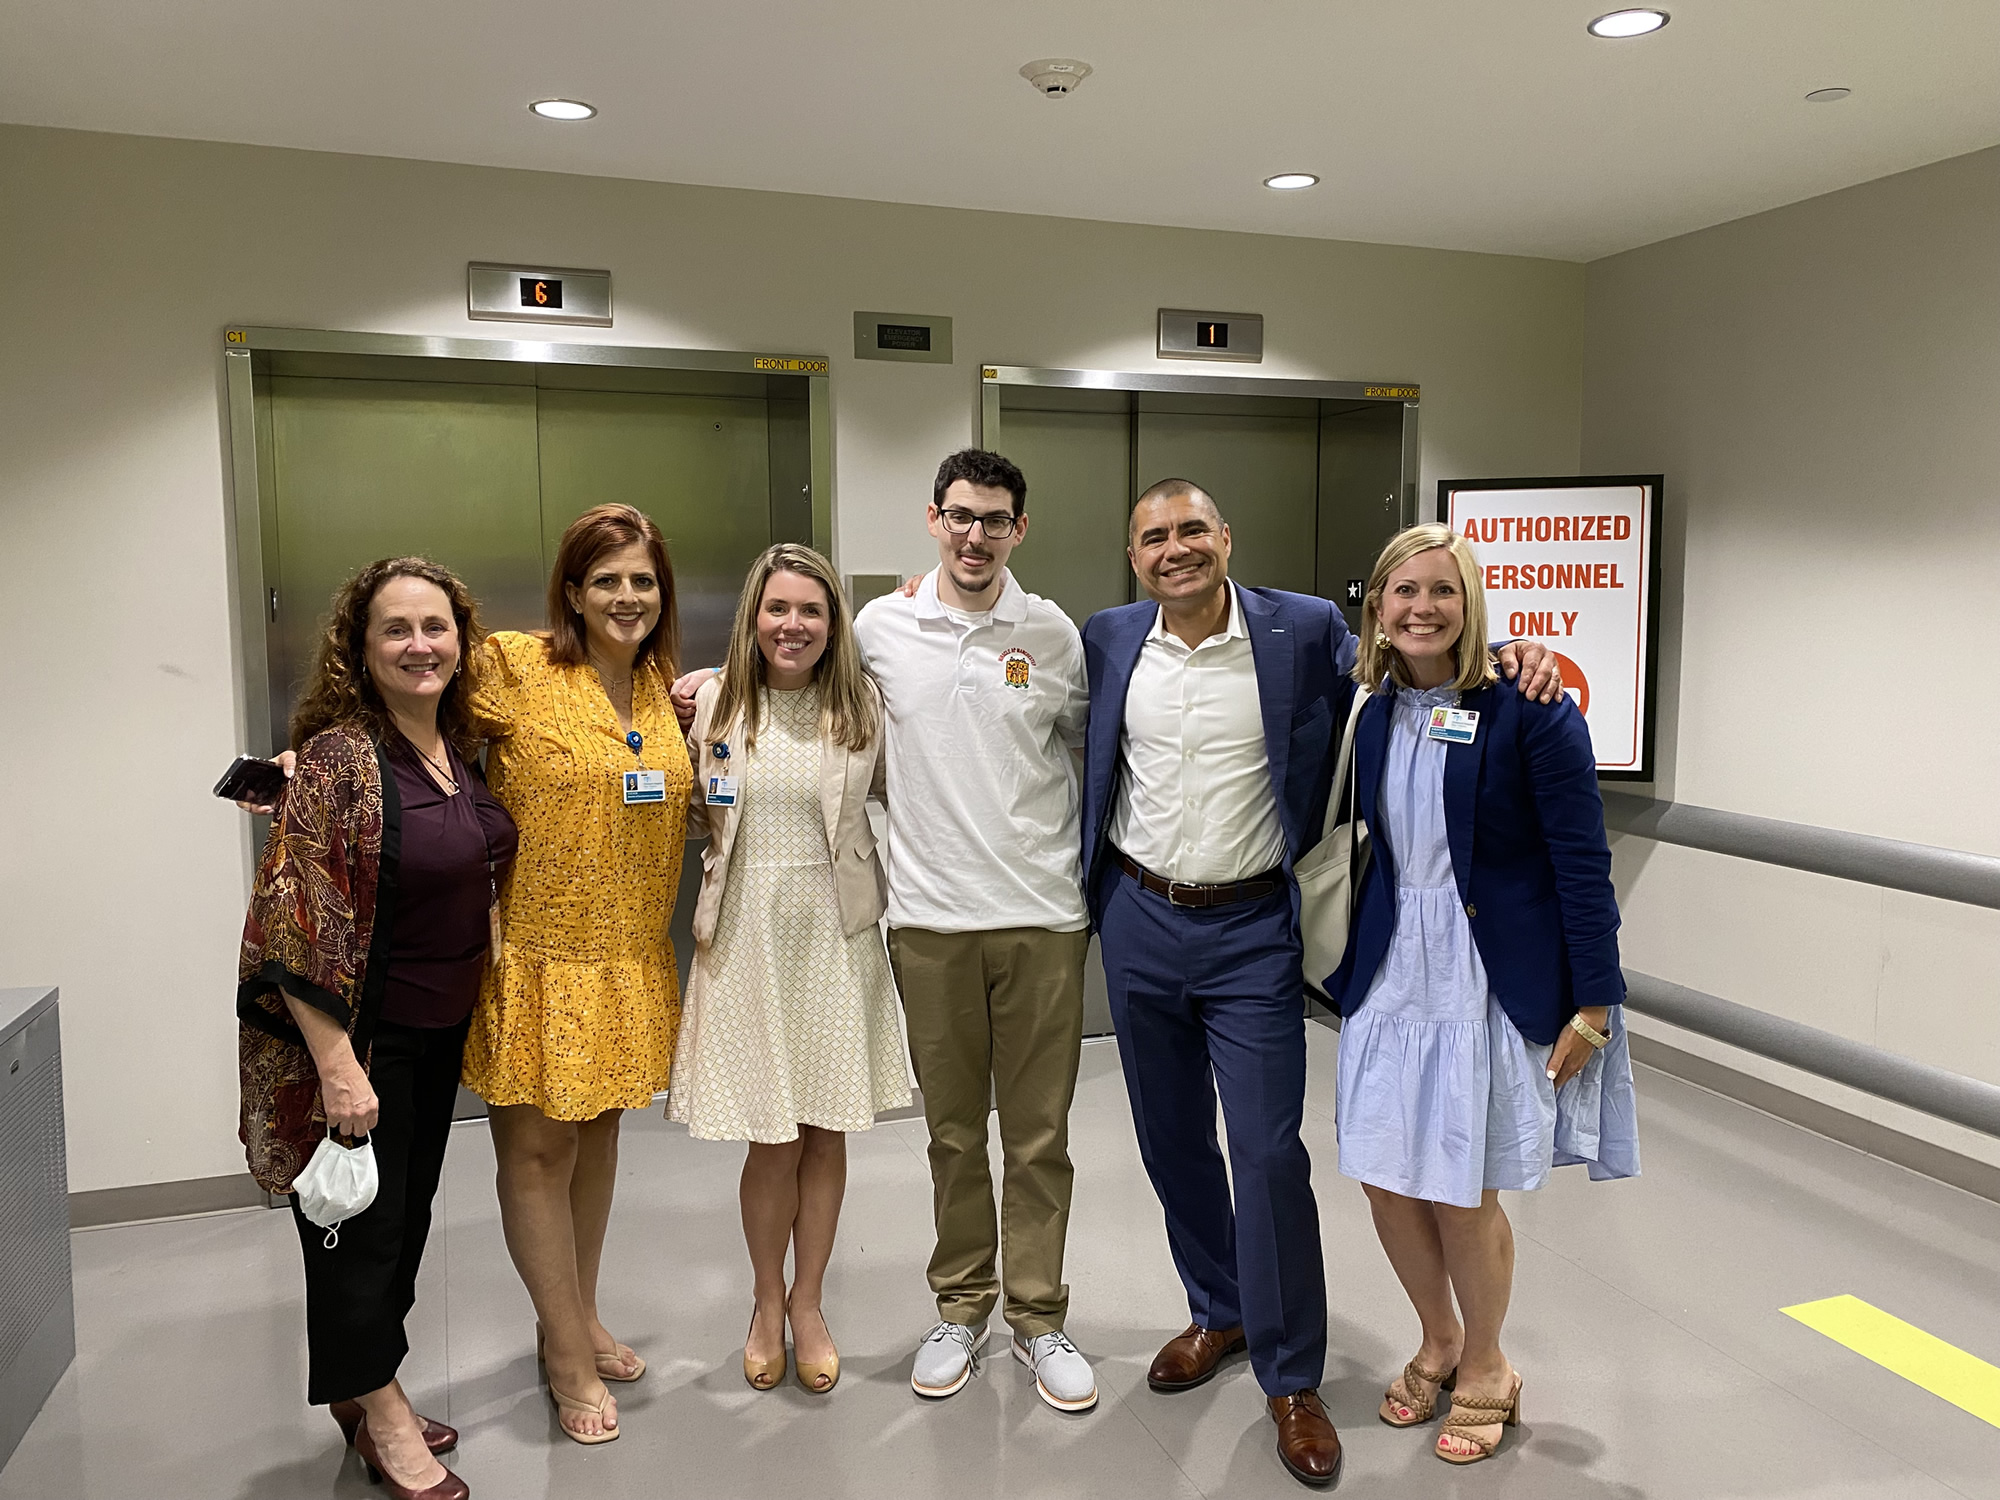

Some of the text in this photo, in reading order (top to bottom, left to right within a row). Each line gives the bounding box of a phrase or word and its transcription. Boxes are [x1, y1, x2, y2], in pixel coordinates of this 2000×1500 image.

[535, 281, 547, 304] 6
[227, 331, 243, 343] C1
[884, 334, 923, 343] EMERGENCY
[887, 328, 921, 336] ELEVATOR
[1209, 324, 1215, 344] 1
[755, 358, 827, 373] FRONT DOOR
[983, 368, 997, 379] C2
[1365, 387, 1419, 398] FRONT DOOR
[1463, 515, 1632, 544] AUTHORIZED
[1477, 563, 1625, 590] ERSONNEL
[1508, 611, 1579, 637] ONLY
